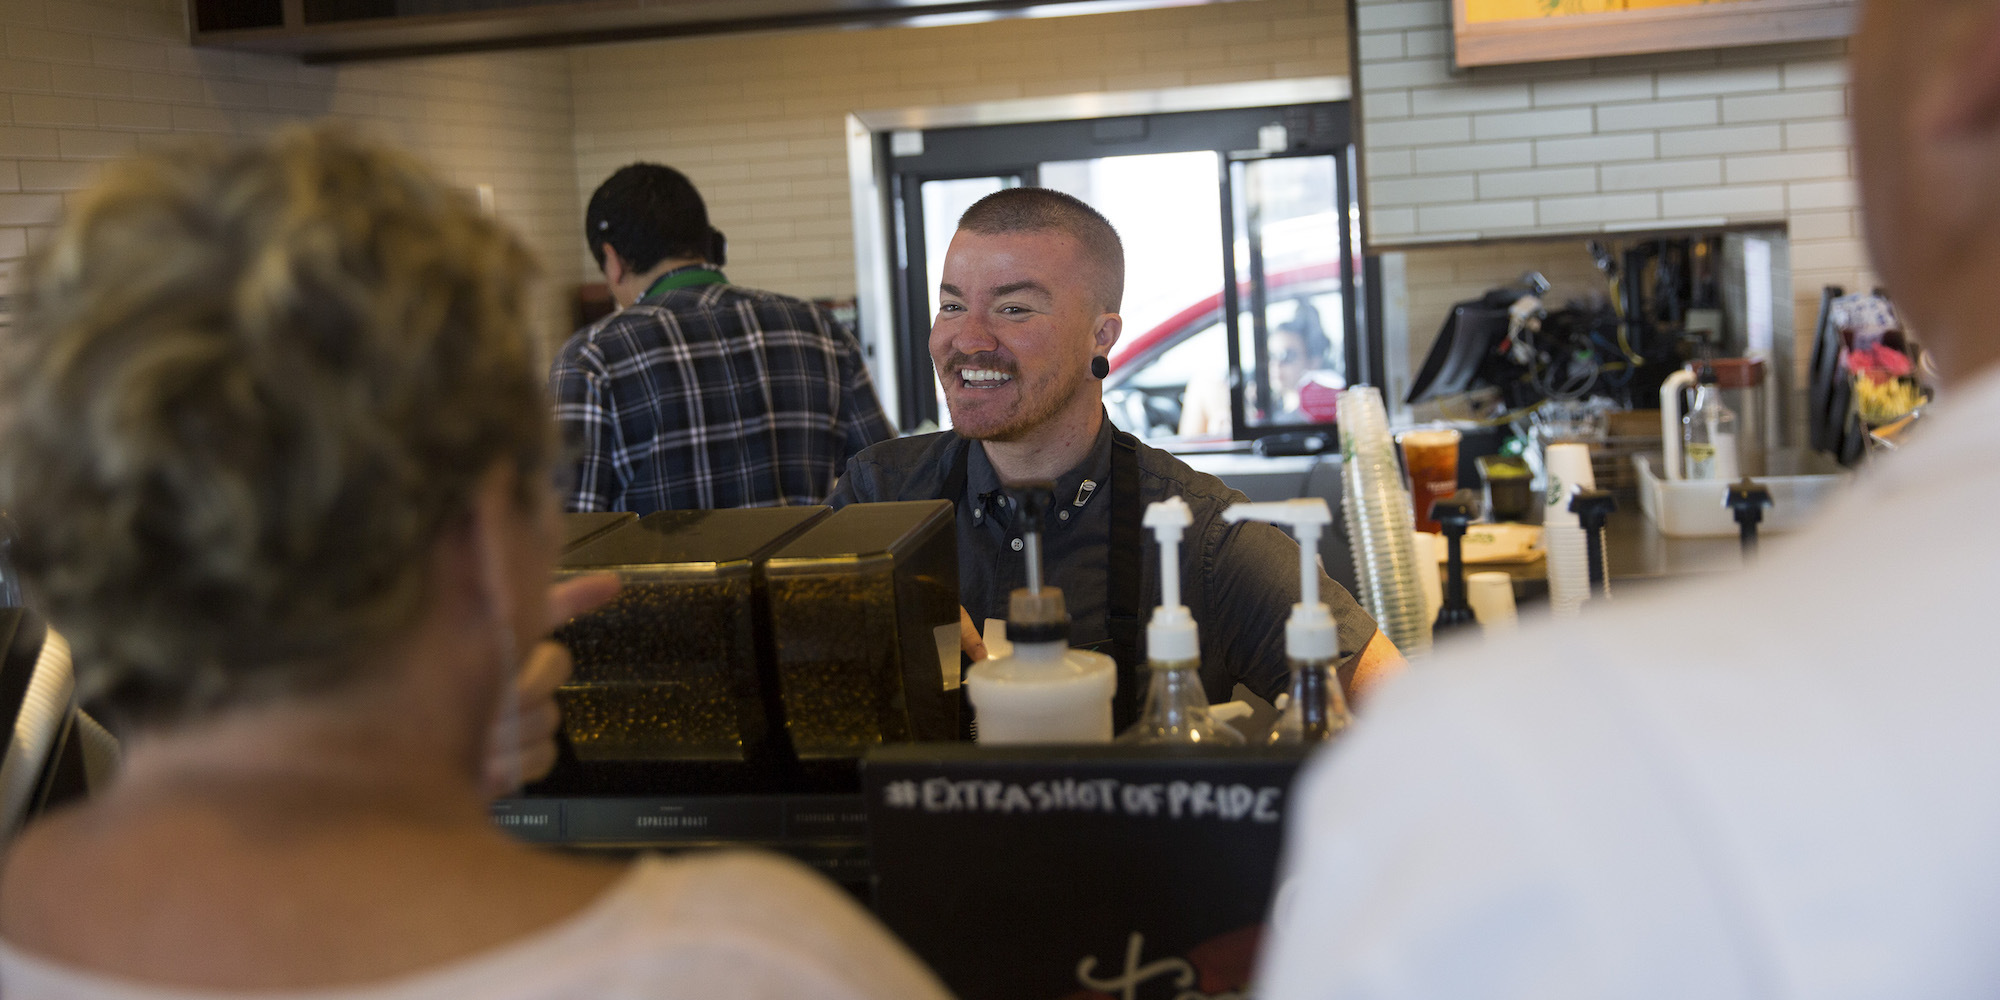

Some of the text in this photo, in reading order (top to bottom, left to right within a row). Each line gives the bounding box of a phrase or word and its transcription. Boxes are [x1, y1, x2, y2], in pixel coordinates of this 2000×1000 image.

[523, 814, 548, 825] ROAST
[637, 816, 708, 827] ESPRESSO ROAST
